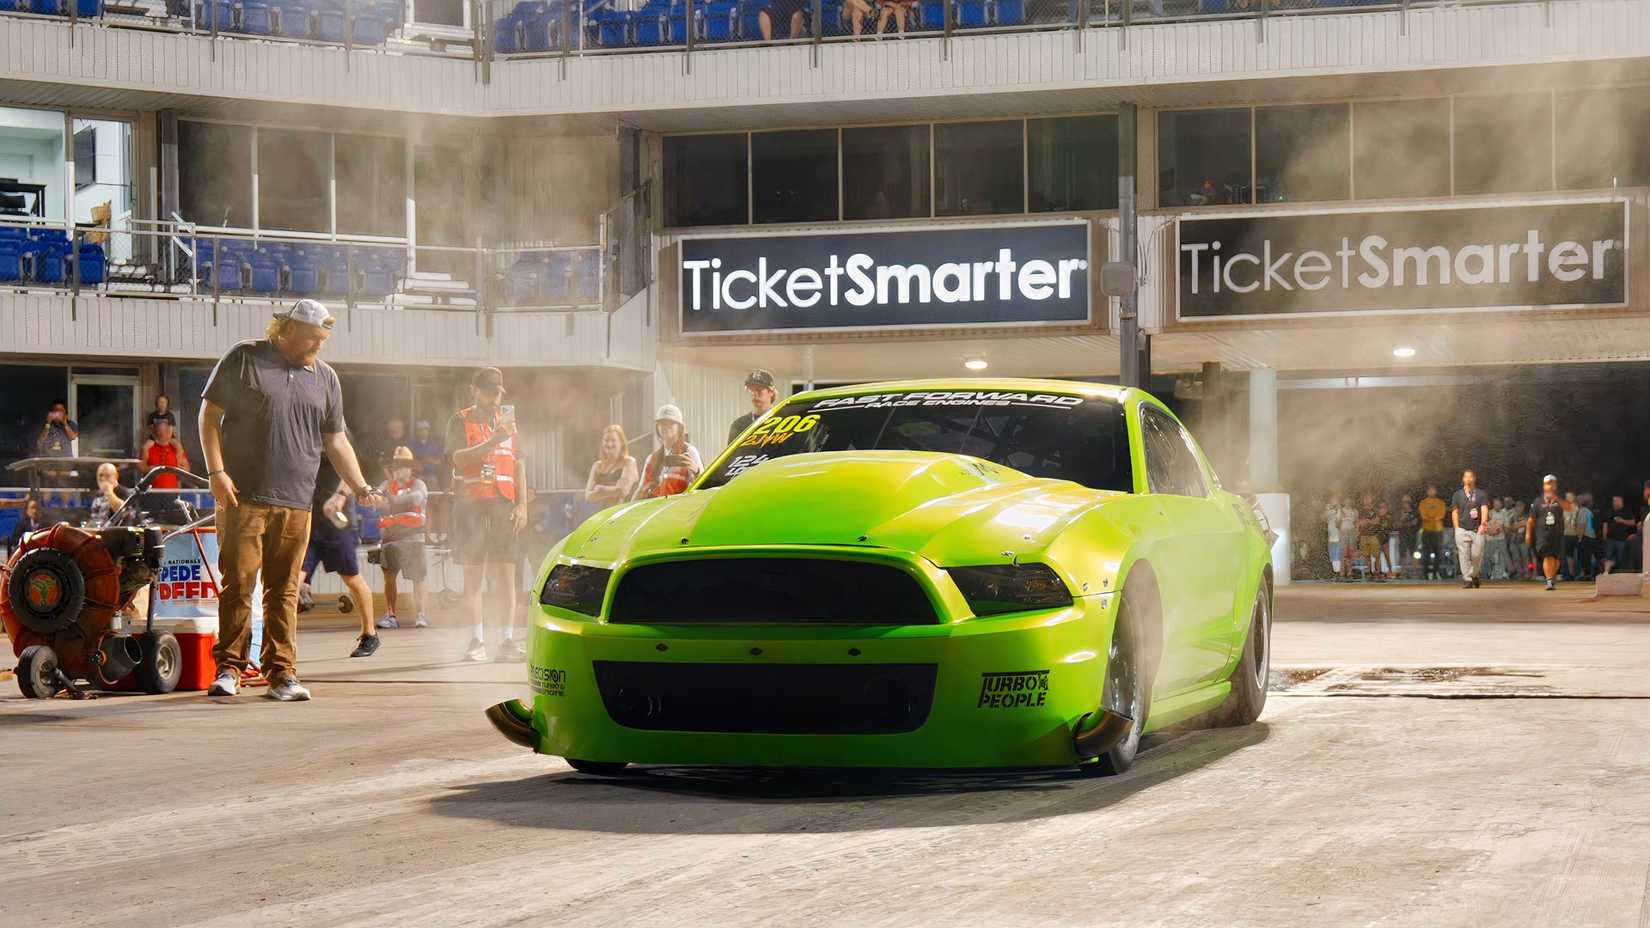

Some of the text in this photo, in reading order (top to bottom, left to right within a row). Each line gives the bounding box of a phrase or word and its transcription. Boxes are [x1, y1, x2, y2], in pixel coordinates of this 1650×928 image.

[1180, 229, 1621, 295] TicketSmarter
[682, 248, 1087, 311] TicketSmarter
[813, 391, 1084, 409] FAST FORWARD
[863, 399, 1011, 409] RACE ENGINES
[752, 414, 821, 435] 206
[159, 564, 201, 582] PEDE
[977, 691, 1047, 708] PEOPLE
